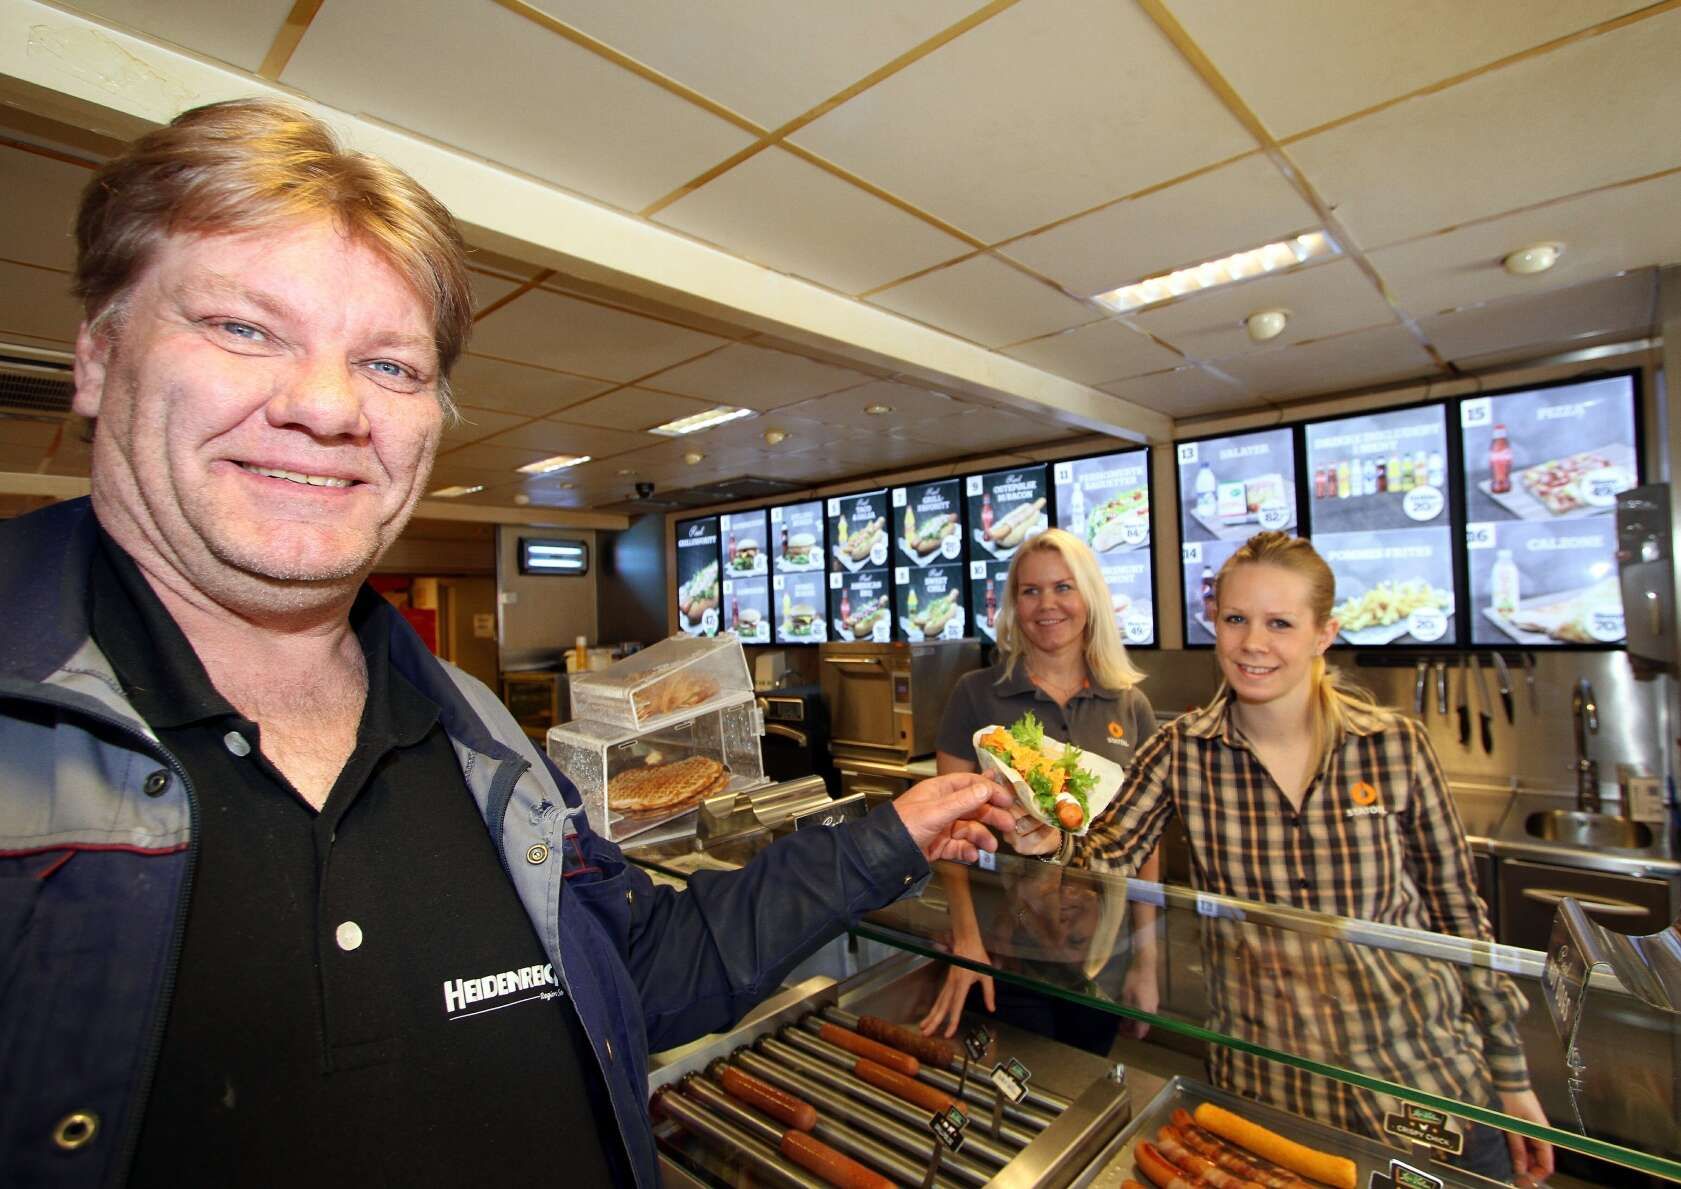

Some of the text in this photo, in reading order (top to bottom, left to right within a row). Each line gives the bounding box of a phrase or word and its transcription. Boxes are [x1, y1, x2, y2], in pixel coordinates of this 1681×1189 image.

[1467, 407, 1486, 421] 15
[1181, 448, 1195, 459] 13
[443, 963, 559, 1013] HEIDENREIC
